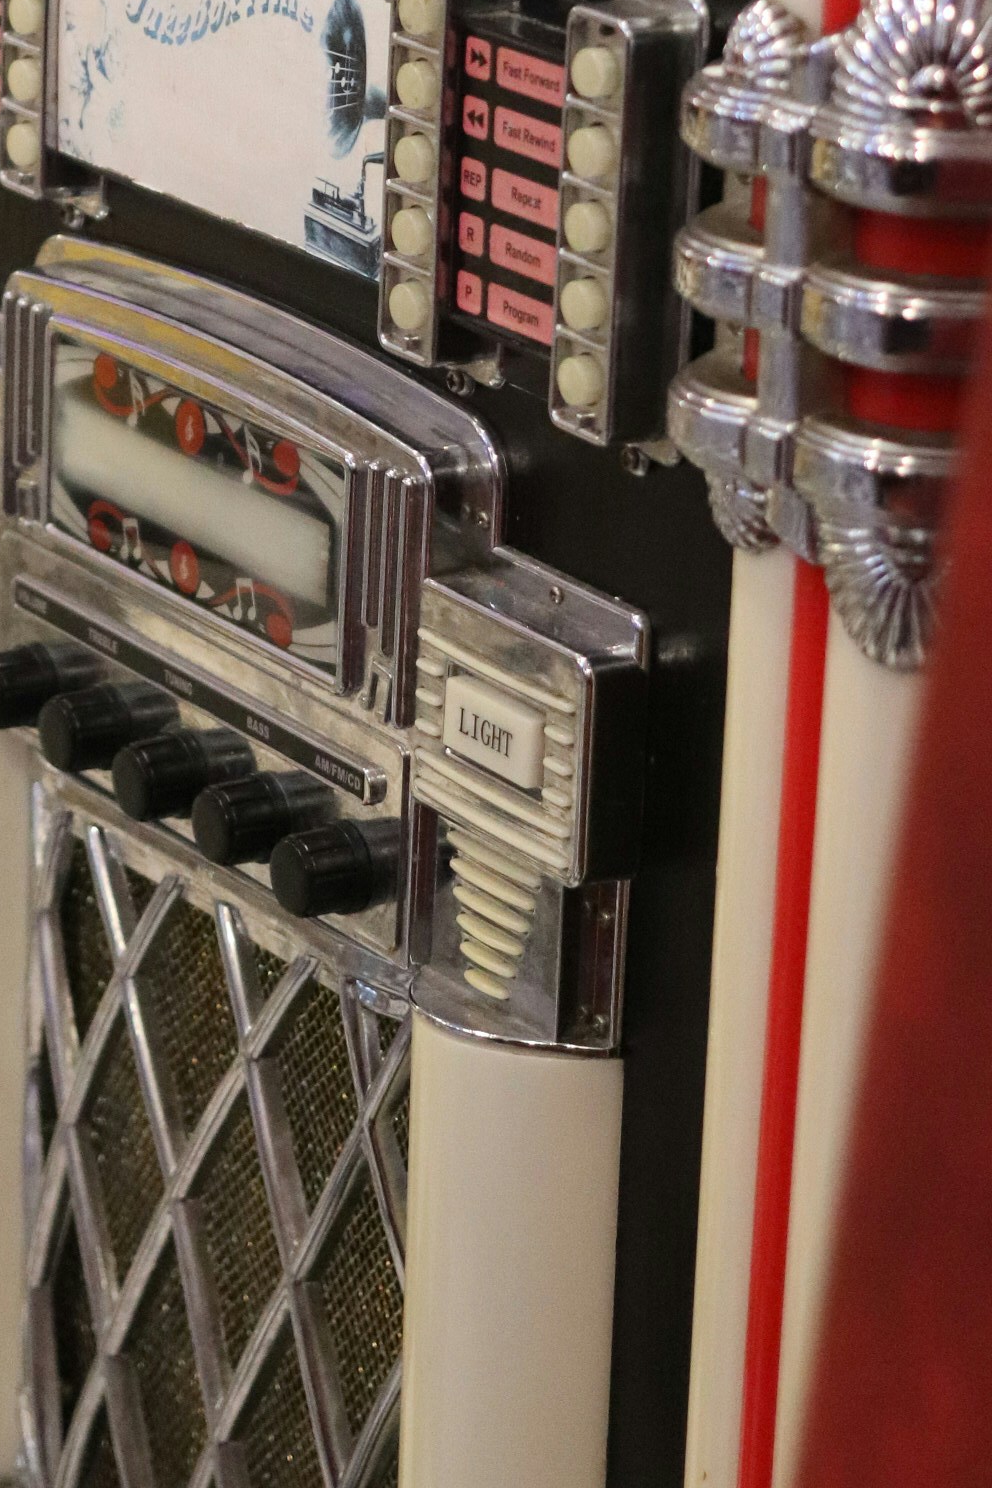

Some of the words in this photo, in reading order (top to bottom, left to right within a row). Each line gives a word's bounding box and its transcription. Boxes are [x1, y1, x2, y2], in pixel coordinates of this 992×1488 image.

[502, 60, 522, 78] Fast
[523, 67, 560, 92] Forward
[502, 120, 522, 140] Fast
[523, 128, 556, 153] Rewind
[463, 169, 482, 187] REP
[511, 185, 542, 211] Repeat
[466, 227, 475, 242] R
[505, 242, 541, 268] Random
[465, 285, 473, 298] P
[502, 300, 540, 327] Program
[246, 716, 271, 739] BASS
[459, 707, 513, 758] LIGHT
[314, 754, 361, 790] AM/FM/CD
